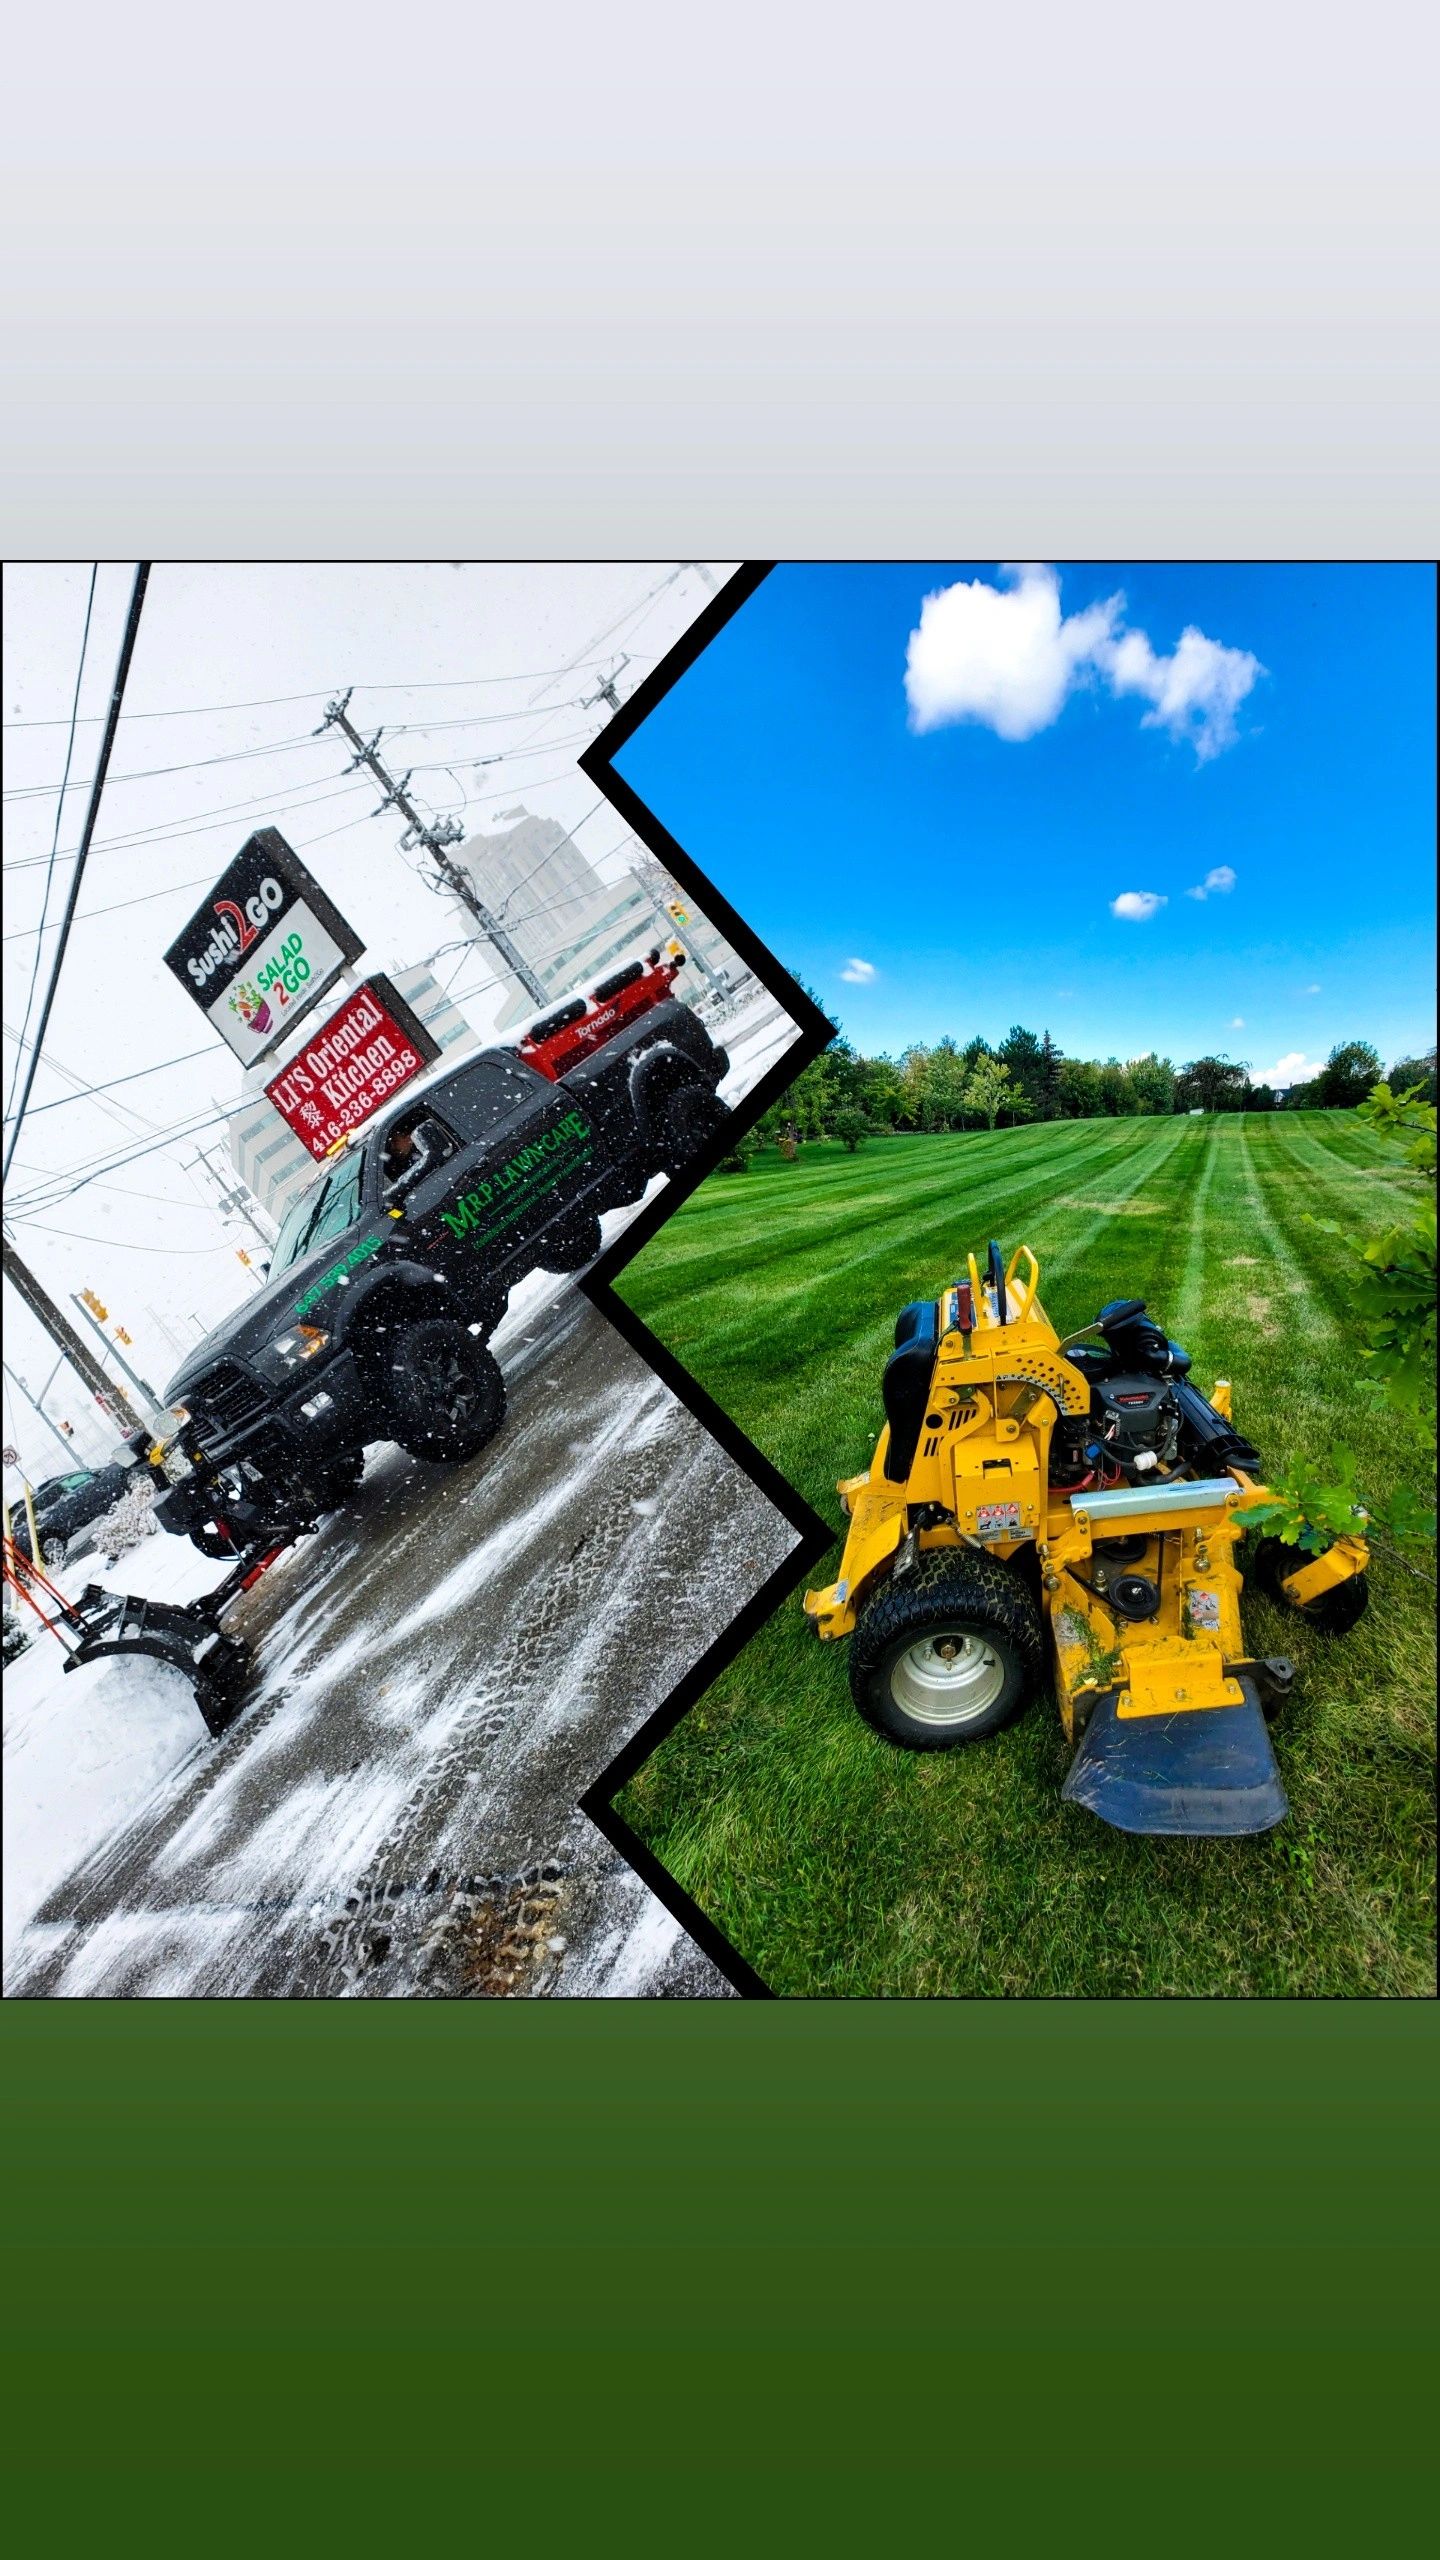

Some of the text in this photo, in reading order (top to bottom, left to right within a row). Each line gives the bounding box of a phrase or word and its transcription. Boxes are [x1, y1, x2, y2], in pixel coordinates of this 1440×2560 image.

[257, 932, 303, 993] SALAD
[273, 956, 311, 1006] 2GO
[306, 994, 383, 1079] Oriental
[575, 1008, 616, 1037] Tornado
[312, 1049, 417, 1154] 416-236-8898
[320, 1033, 396, 1110] Kitchen
[299, 1100, 325, 1130] 黎
[493, 1141, 545, 1190] LAWN
[541, 1110, 591, 1150] CARE
